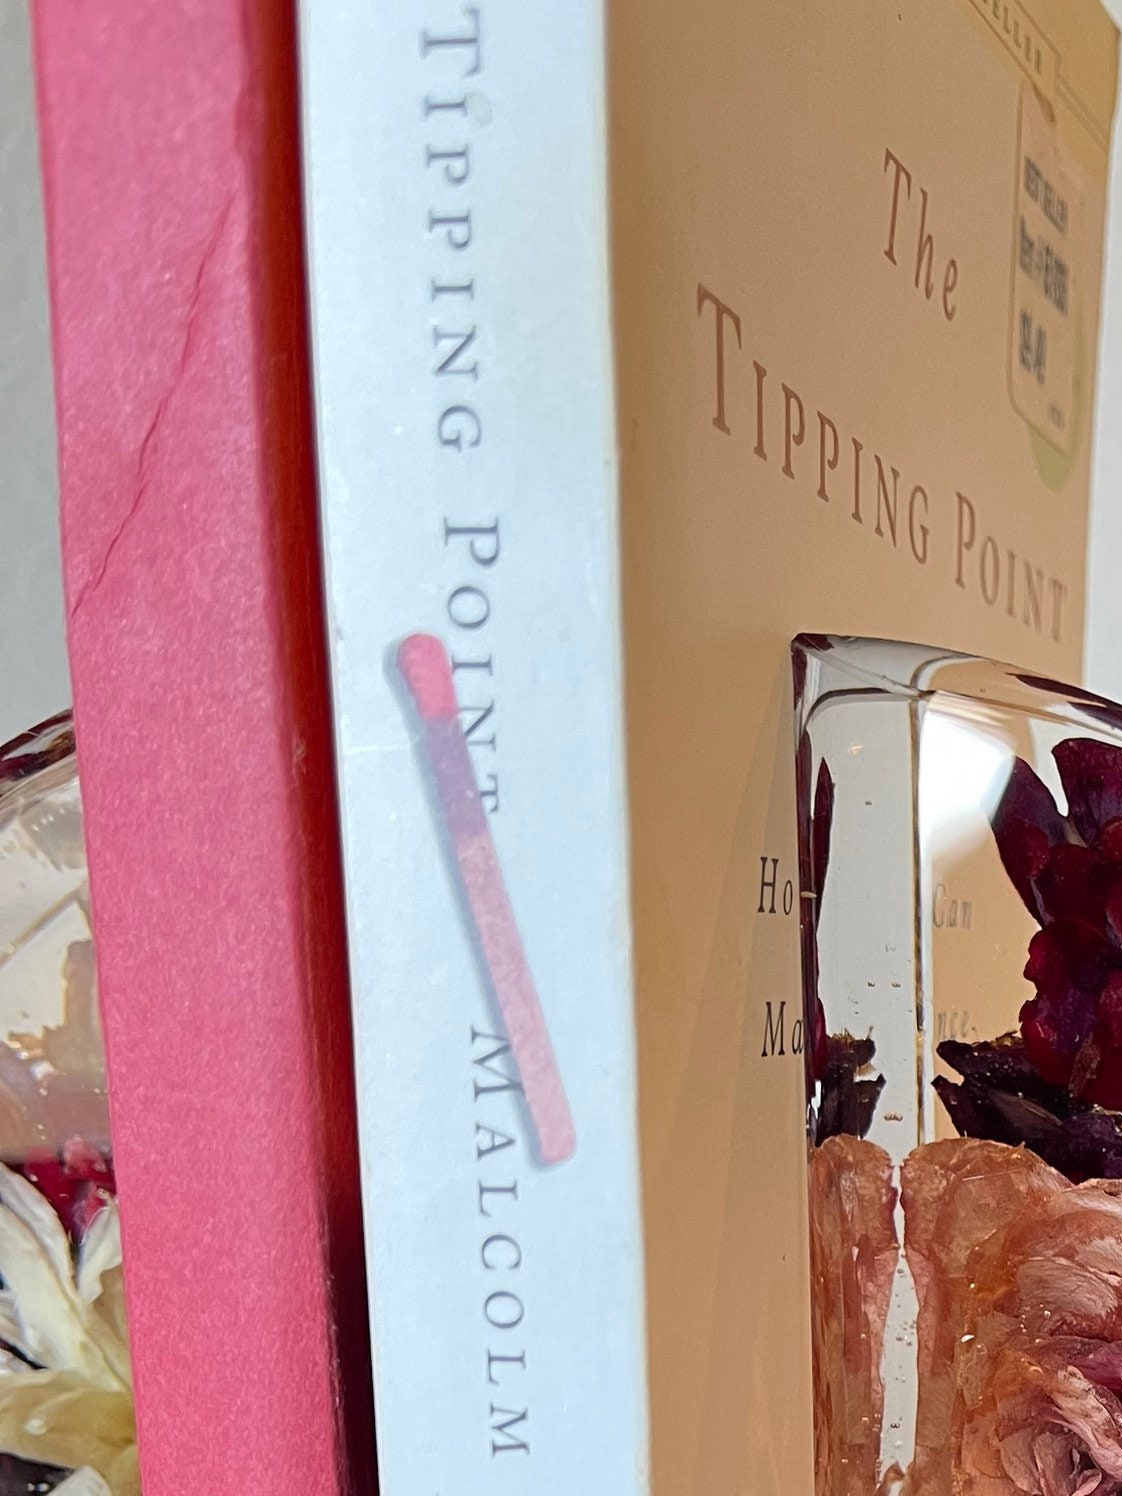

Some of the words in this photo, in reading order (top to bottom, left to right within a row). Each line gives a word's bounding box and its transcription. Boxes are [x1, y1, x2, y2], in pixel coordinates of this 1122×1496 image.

[418, 6, 483, 453] TIPPING
[884, 147, 959, 322] The
[697, 282, 929, 565] TIPPING
[954, 490, 1069, 643] POINT
[757, 857, 793, 915] Ho
[761, 1001, 804, 1057] Ma
